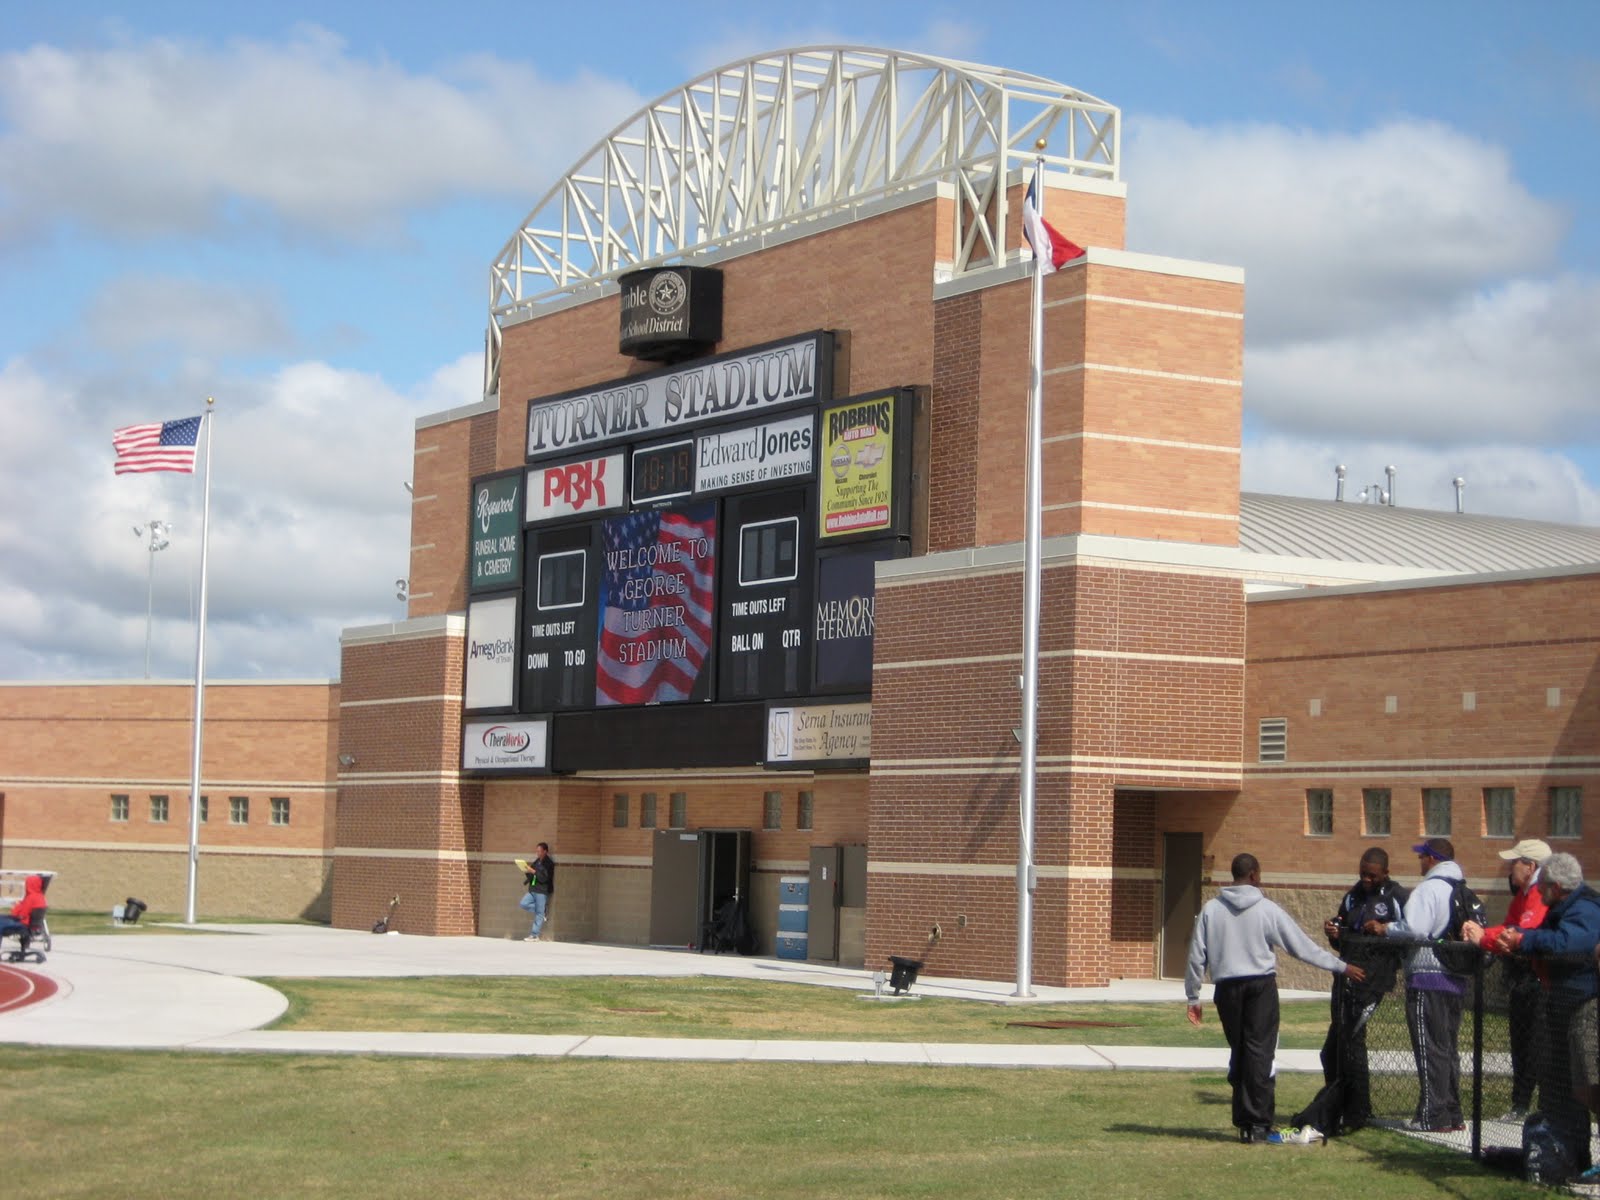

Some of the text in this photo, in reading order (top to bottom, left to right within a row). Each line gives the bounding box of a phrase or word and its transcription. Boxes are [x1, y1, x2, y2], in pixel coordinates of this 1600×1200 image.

[649, 315, 683, 333] District
[531, 343, 815, 450] TURNER STADIUM
[829, 401, 890, 447] ROBBINS
[843, 426, 876, 440] AUTO MALL
[544, 458, 606, 511] PBK
[700, 460, 811, 490] MAKING SENSE OF INVESTING
[836, 480, 879, 499] Supporting The
[477, 486, 517, 533] Rosewood
[827, 497, 858, 511] Community
[858, 495, 873, 507] Since
[475, 535, 516, 556] FUNERAL HOME
[607, 537, 708, 571] WELCOME TO
[477, 557, 512, 577] & CEMETERY
[624, 573, 686, 600] GEORGE
[732, 597, 786, 616] TIME OUTS LEFT
[623, 605, 685, 632] TURNER
[531, 621, 576, 637] TIME OUTS LEFT
[782, 629, 801, 648] QTR
[619, 637, 687, 663] STADIUM
[731, 632, 764, 652] BALL ON
[527, 652, 549, 669] DOWN
[564, 649, 586, 666] TO GO
[797, 711, 827, 731] Serna
[819, 731, 857, 756] Agency
